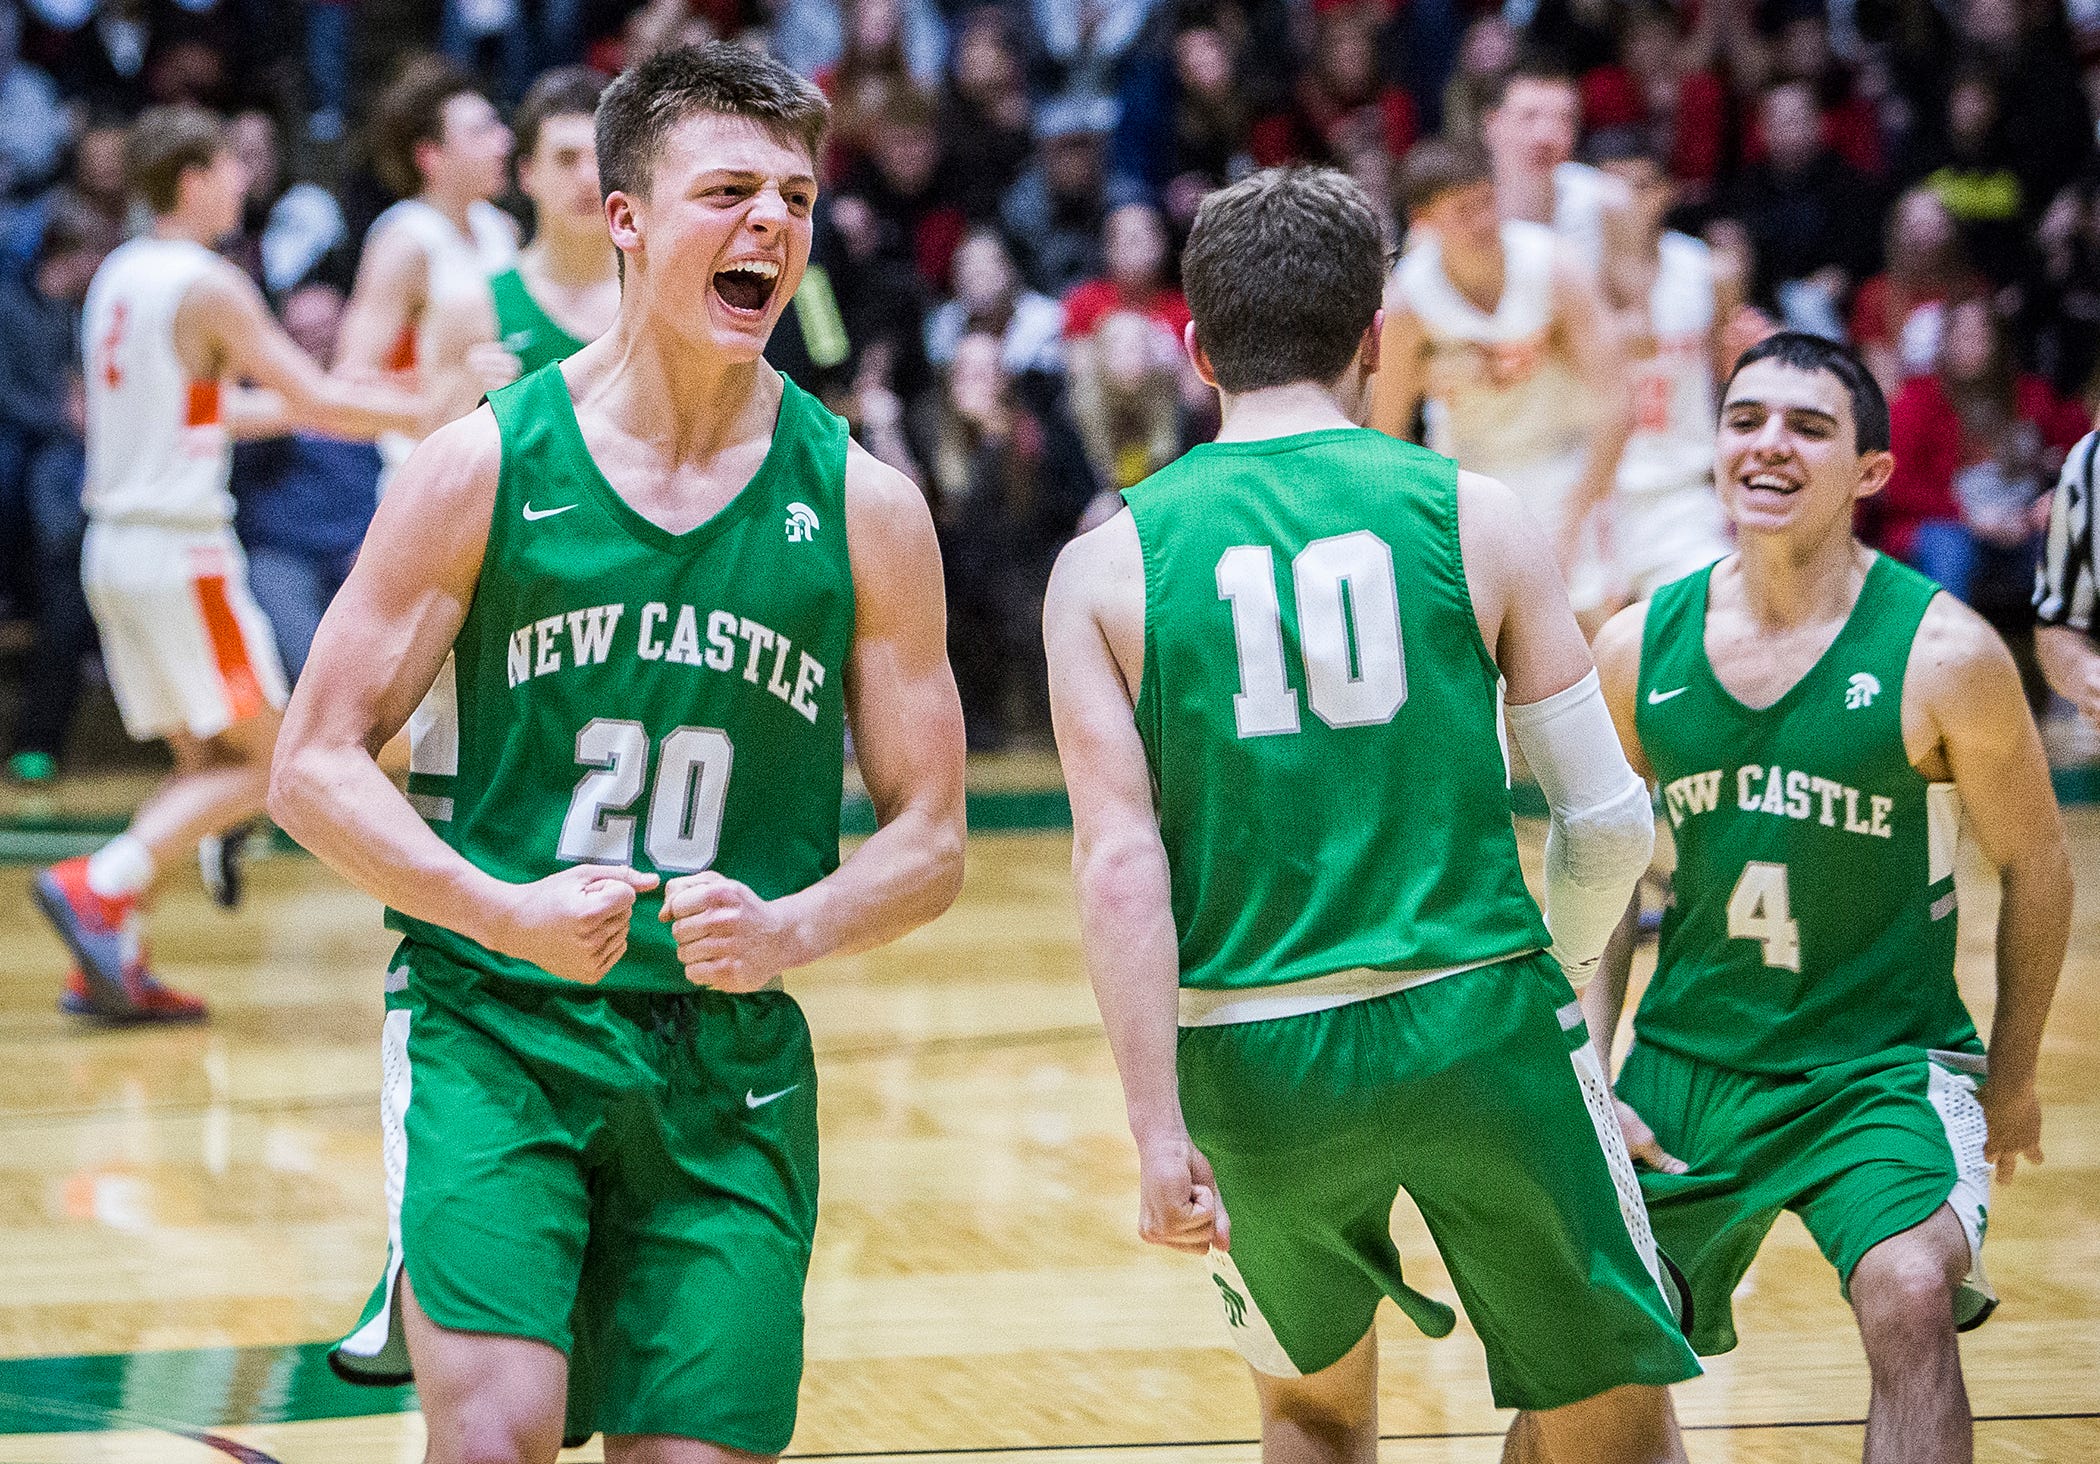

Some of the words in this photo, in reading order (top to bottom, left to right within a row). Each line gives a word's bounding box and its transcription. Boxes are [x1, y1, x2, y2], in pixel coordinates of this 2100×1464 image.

[507, 602, 625, 689] NEW
[637, 601, 827, 725] CASTLE
[1215, 528, 1408, 739] 10
[556, 716, 735, 874] 20
[1736, 763, 1893, 839] CASTLE
[1726, 859, 1801, 972] 4
